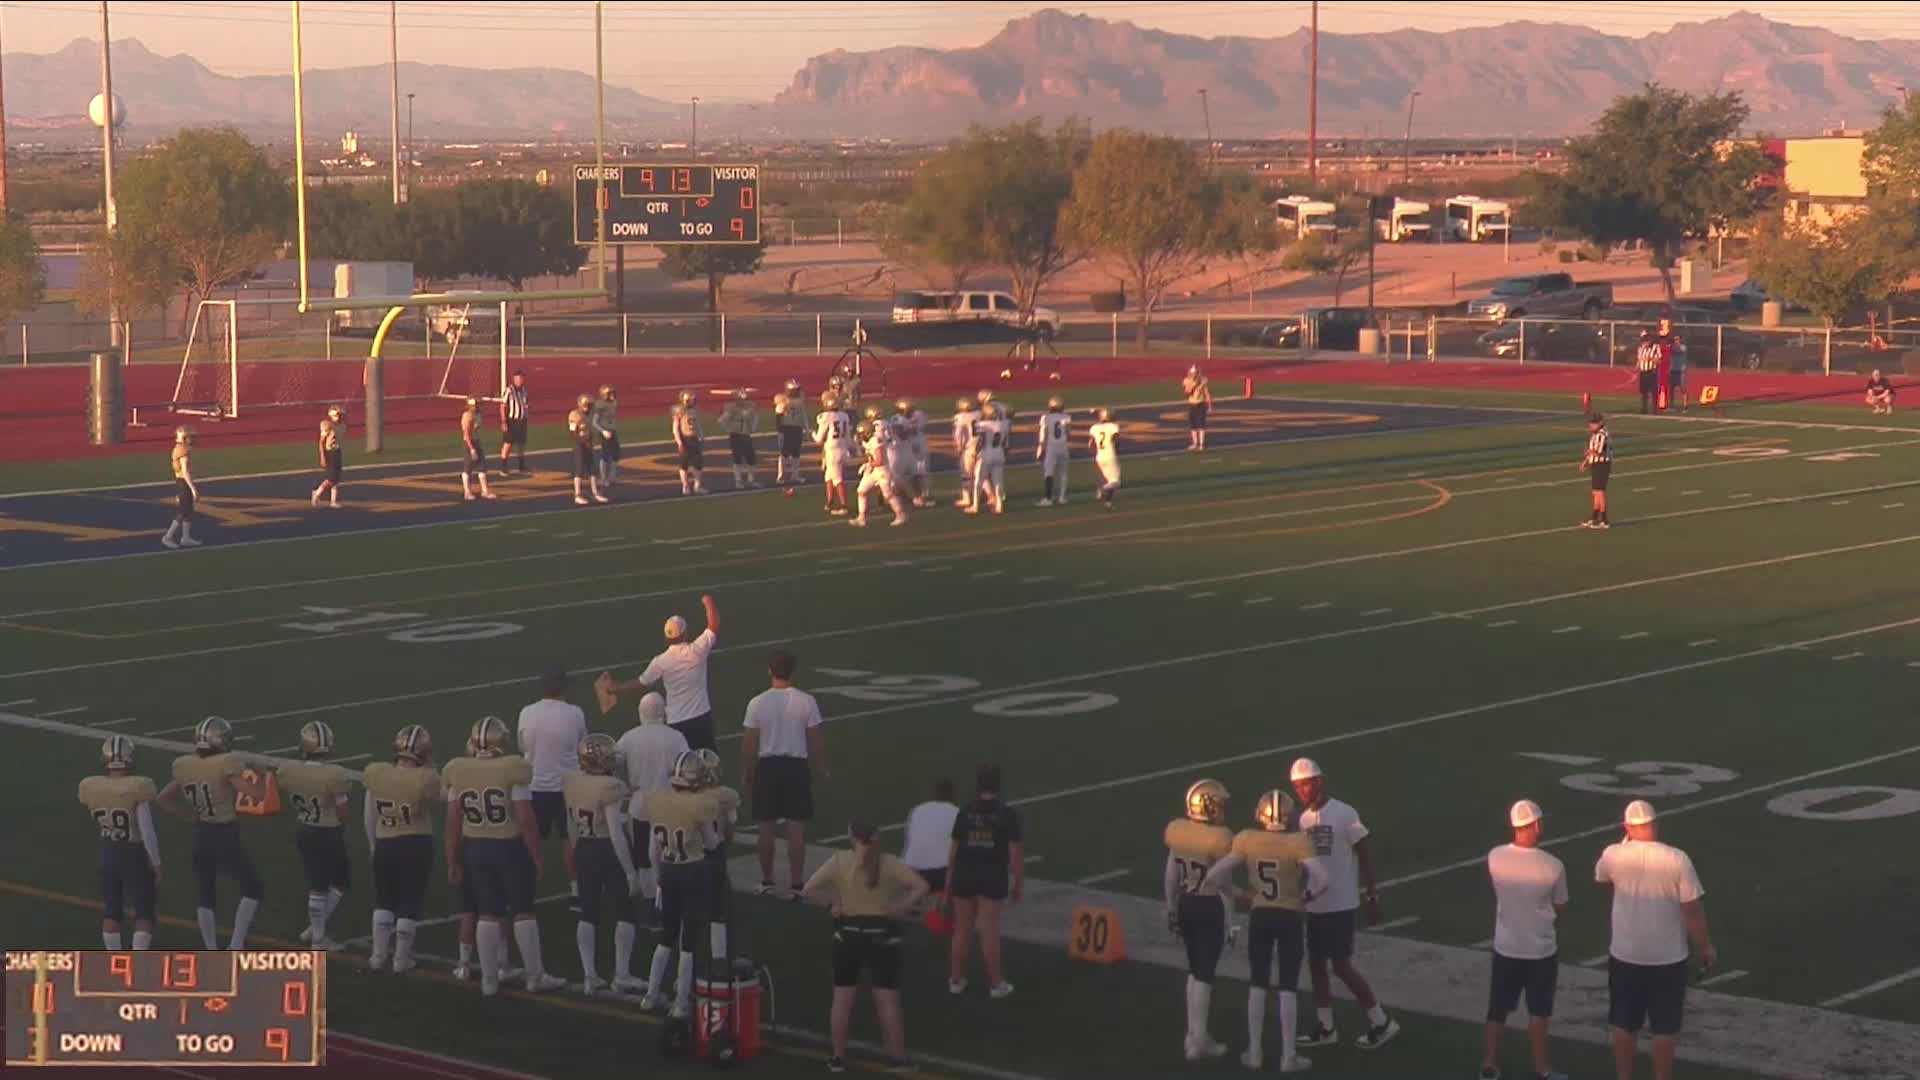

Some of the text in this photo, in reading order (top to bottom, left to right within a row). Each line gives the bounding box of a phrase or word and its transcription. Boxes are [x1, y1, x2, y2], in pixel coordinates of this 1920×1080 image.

[576, 167, 619, 180] CHARERS
[641, 168, 691, 191] 9 13
[714, 167, 756, 180] VISITOR
[646, 202, 669, 214] QTR
[740, 187, 753, 209] 0
[612, 223, 648, 235] DOWN
[680, 218, 744, 240] TO GO 9
[460, 787, 507, 825] 66
[1256, 859, 1280, 901] 5
[1076, 911, 1109, 954] 30
